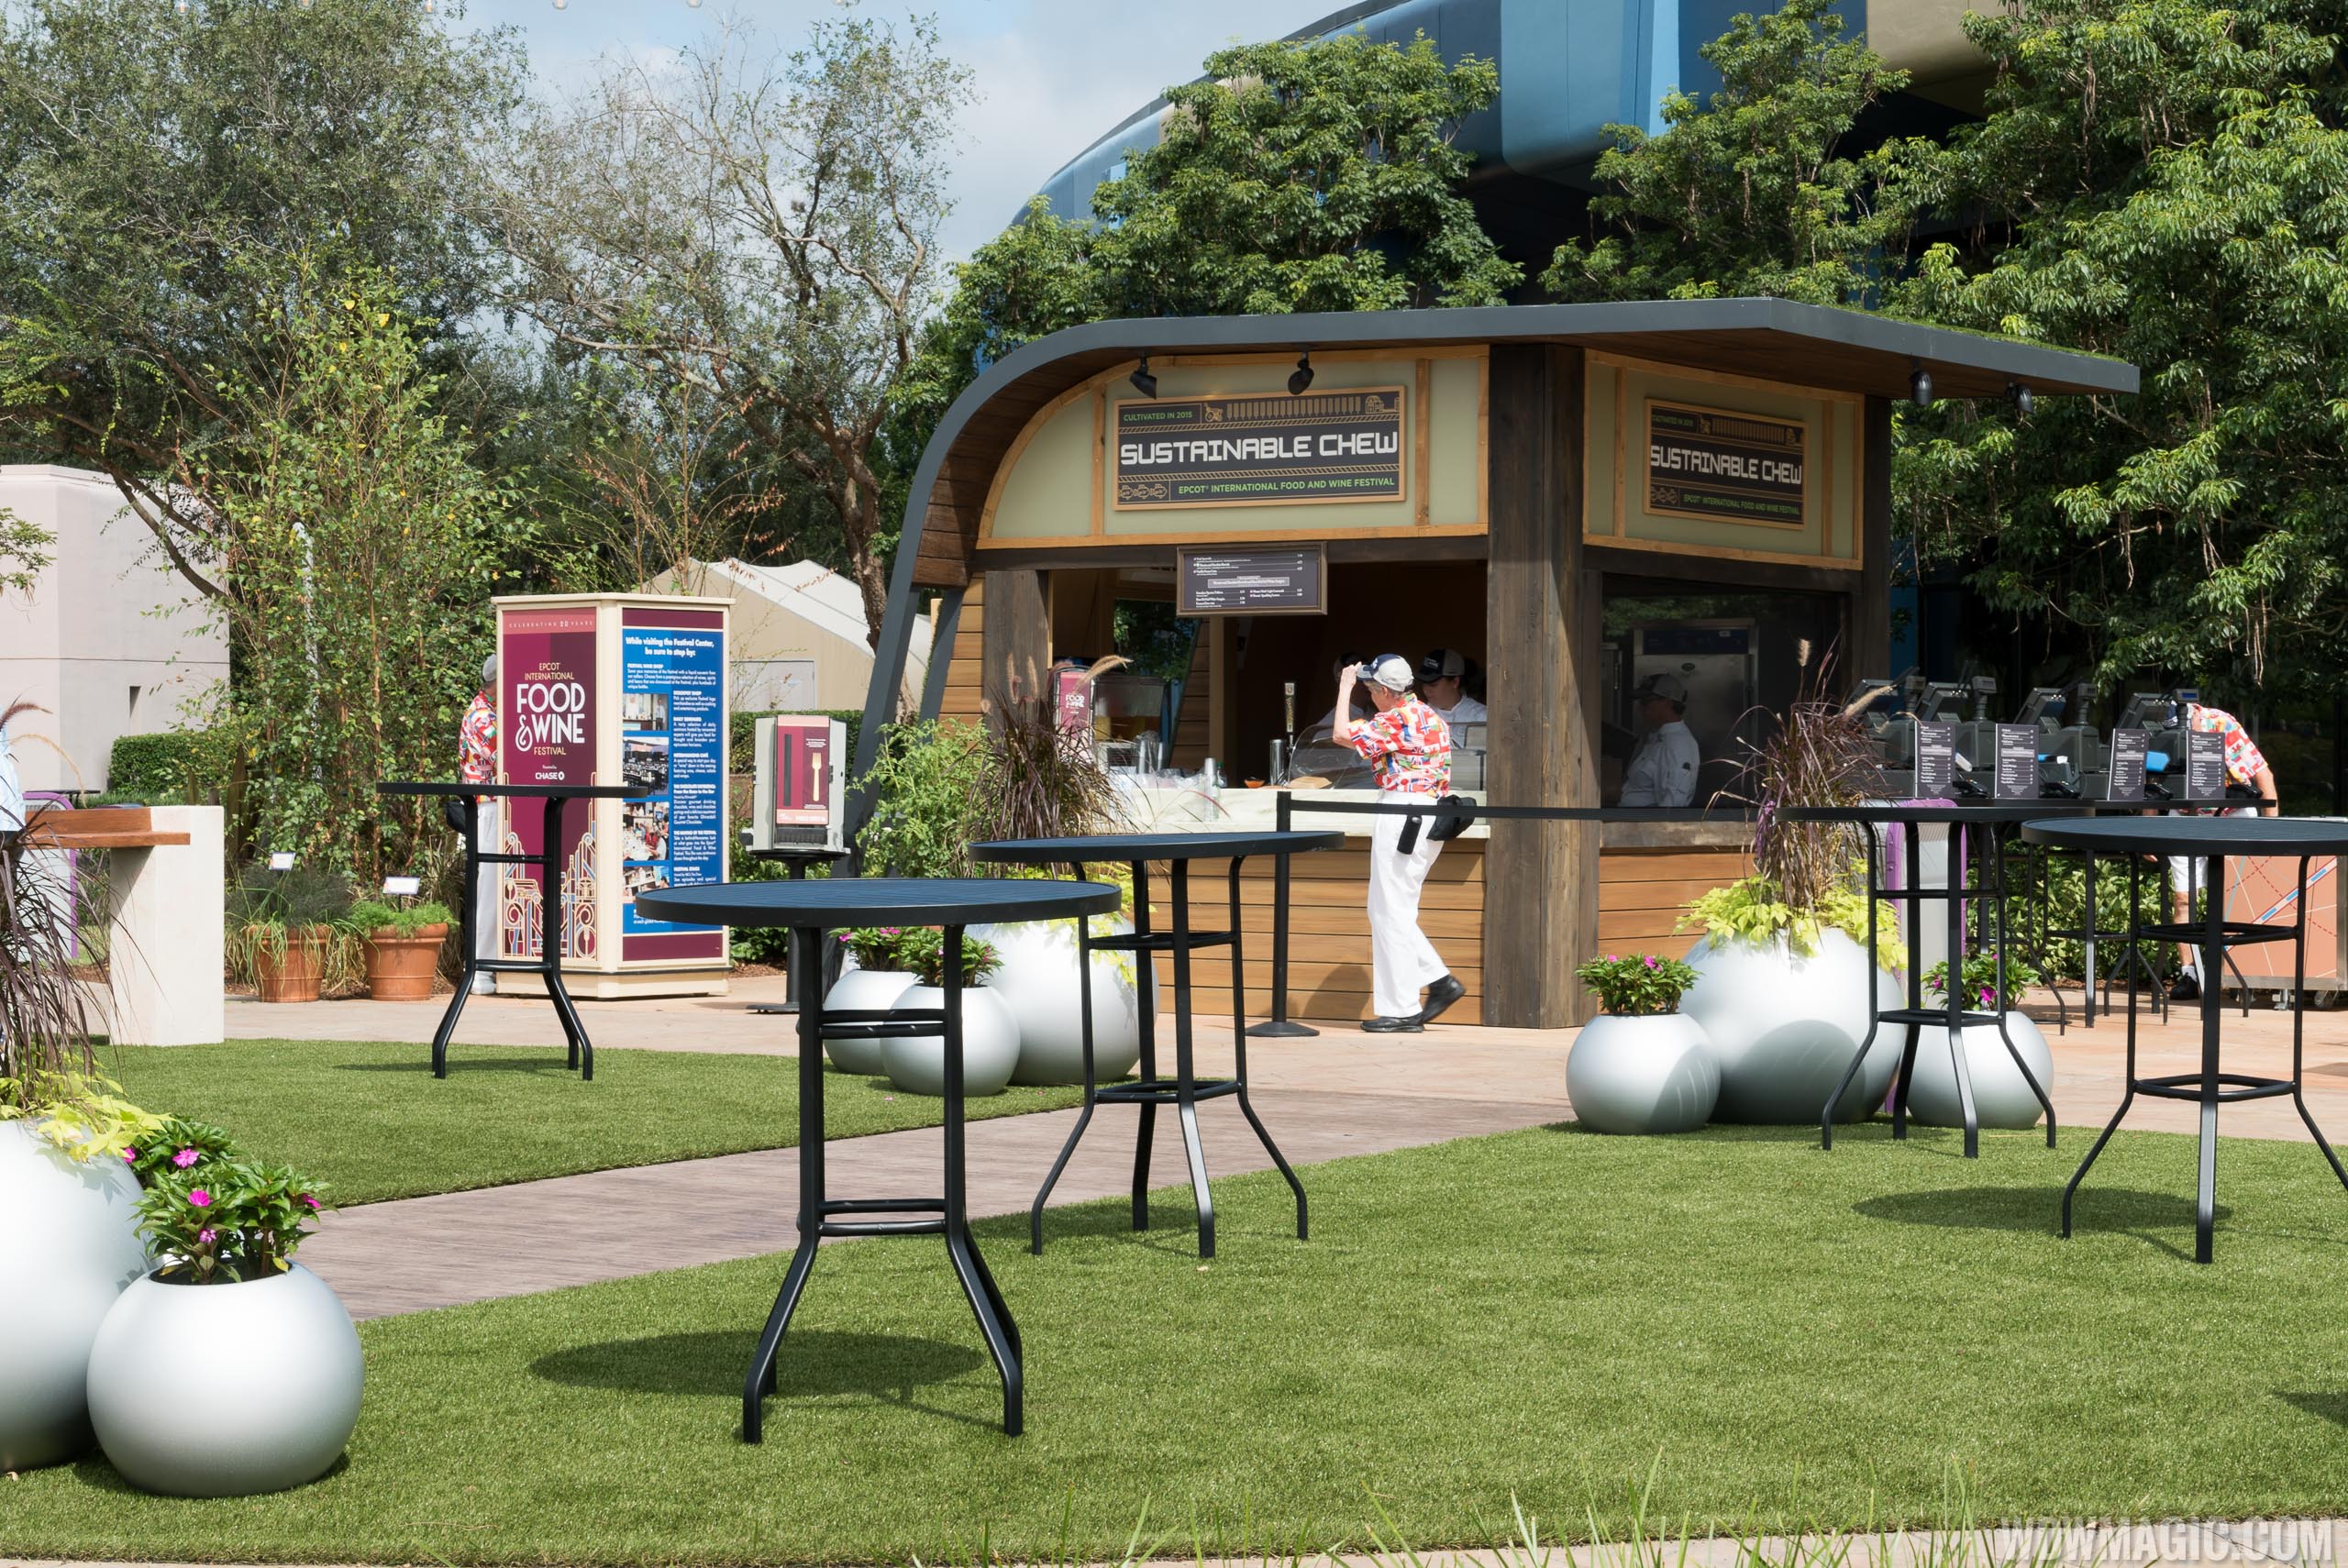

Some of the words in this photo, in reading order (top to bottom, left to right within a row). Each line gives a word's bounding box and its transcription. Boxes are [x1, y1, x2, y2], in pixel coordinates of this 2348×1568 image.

[1124, 412, 1165, 421] CULTIVATED
[1121, 436, 1312, 465] SUSTAINABLE
[1319, 432, 1398, 457] CHEW
[1651, 445, 1758, 479] SUSTAINABLE
[1762, 460, 1801, 484] CHEW
[1211, 481, 1279, 492] INTERNATIONAL
[1280, 481, 1306, 491] FOOD
[1308, 480, 1326, 489] AND
[1330, 479, 1352, 488] WINE
[1354, 478, 1394, 487] FESTIVAL
[626, 636, 642, 645] While
[643, 636, 663, 647] visiting
[664, 637, 673, 646] the
[673, 638, 694, 646] Festival
[695, 639, 714, 648] Center,
[645, 646, 652, 655] be
[673, 648, 685, 657] stop
[525, 672, 574, 680] INTERNATIONAL
[516, 682, 586, 713] FOOD
[531, 713, 585, 744] WINE
[534, 746, 567, 756] FESTIVAL
[535, 772, 559, 780] CHASE
